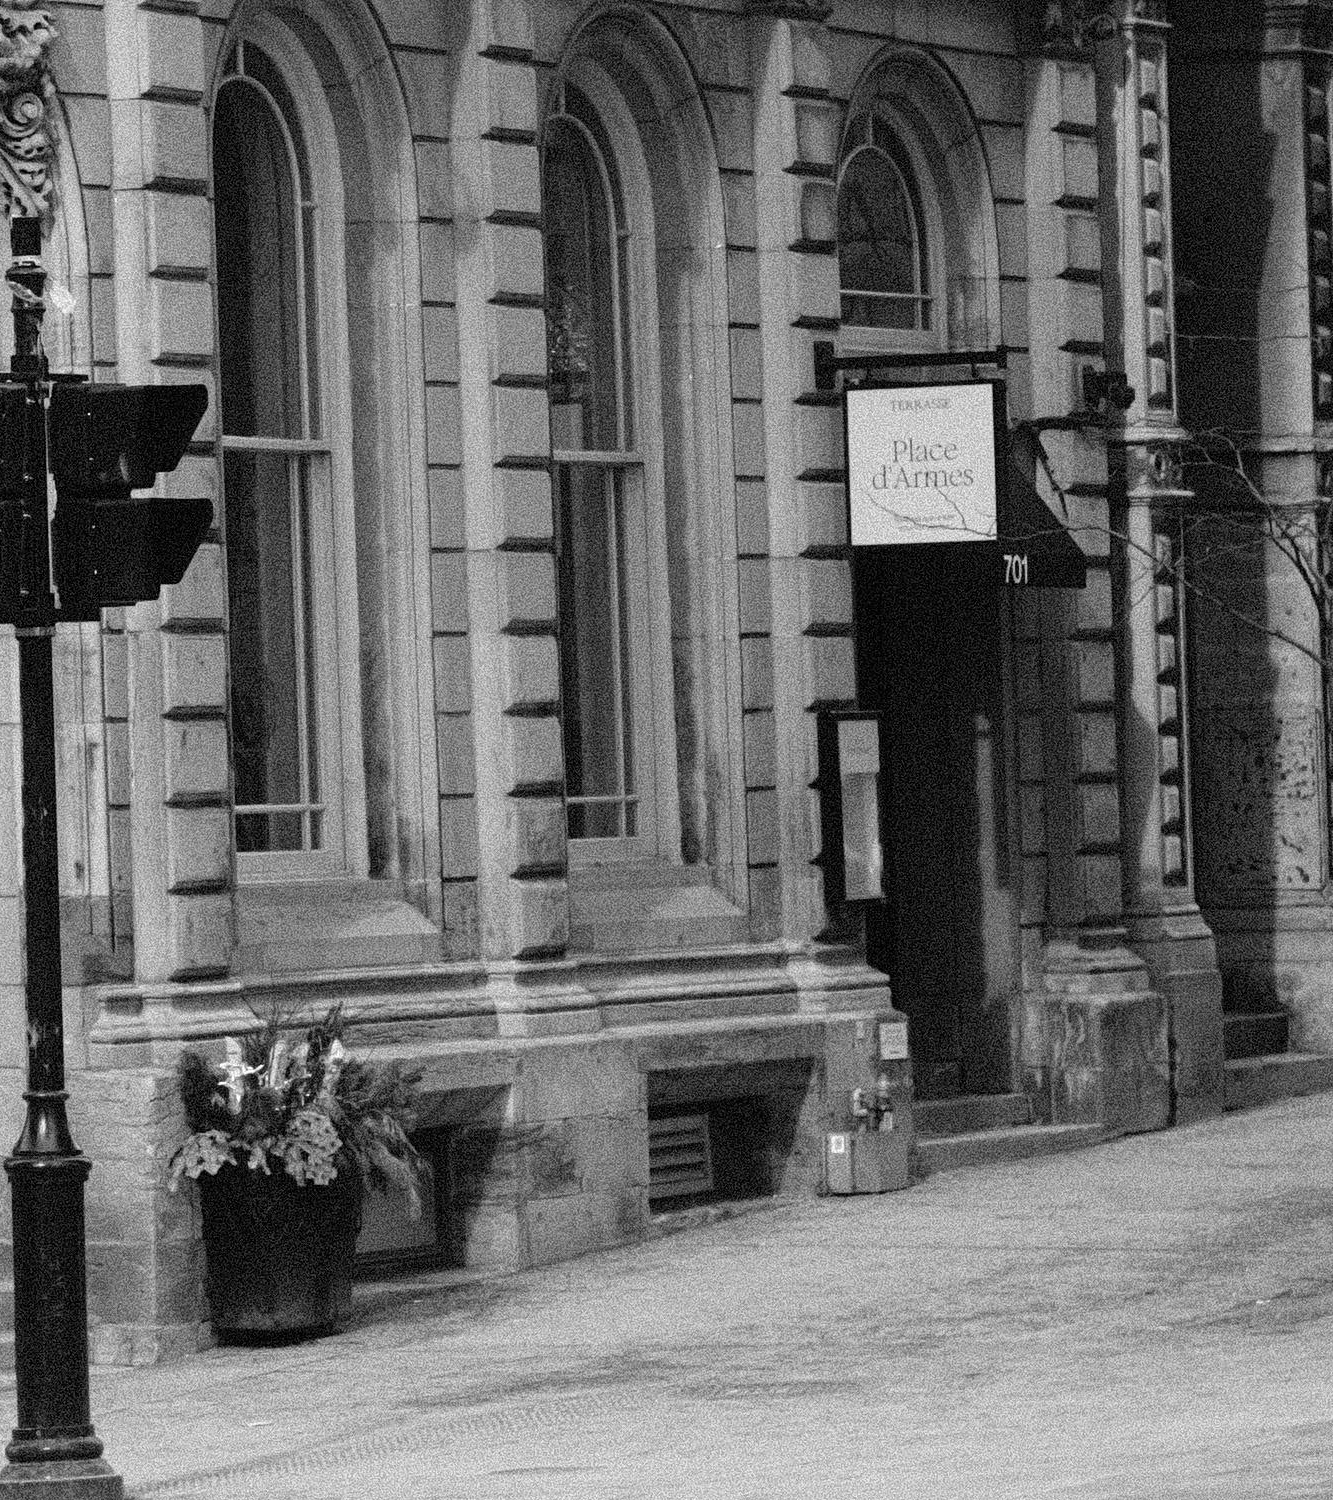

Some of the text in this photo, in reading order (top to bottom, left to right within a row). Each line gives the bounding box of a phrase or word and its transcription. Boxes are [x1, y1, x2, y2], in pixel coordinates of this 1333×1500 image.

[892, 437, 958, 463] Place
[872, 465, 974, 490] d'Armes
[1003, 553, 1028, 584] 701
